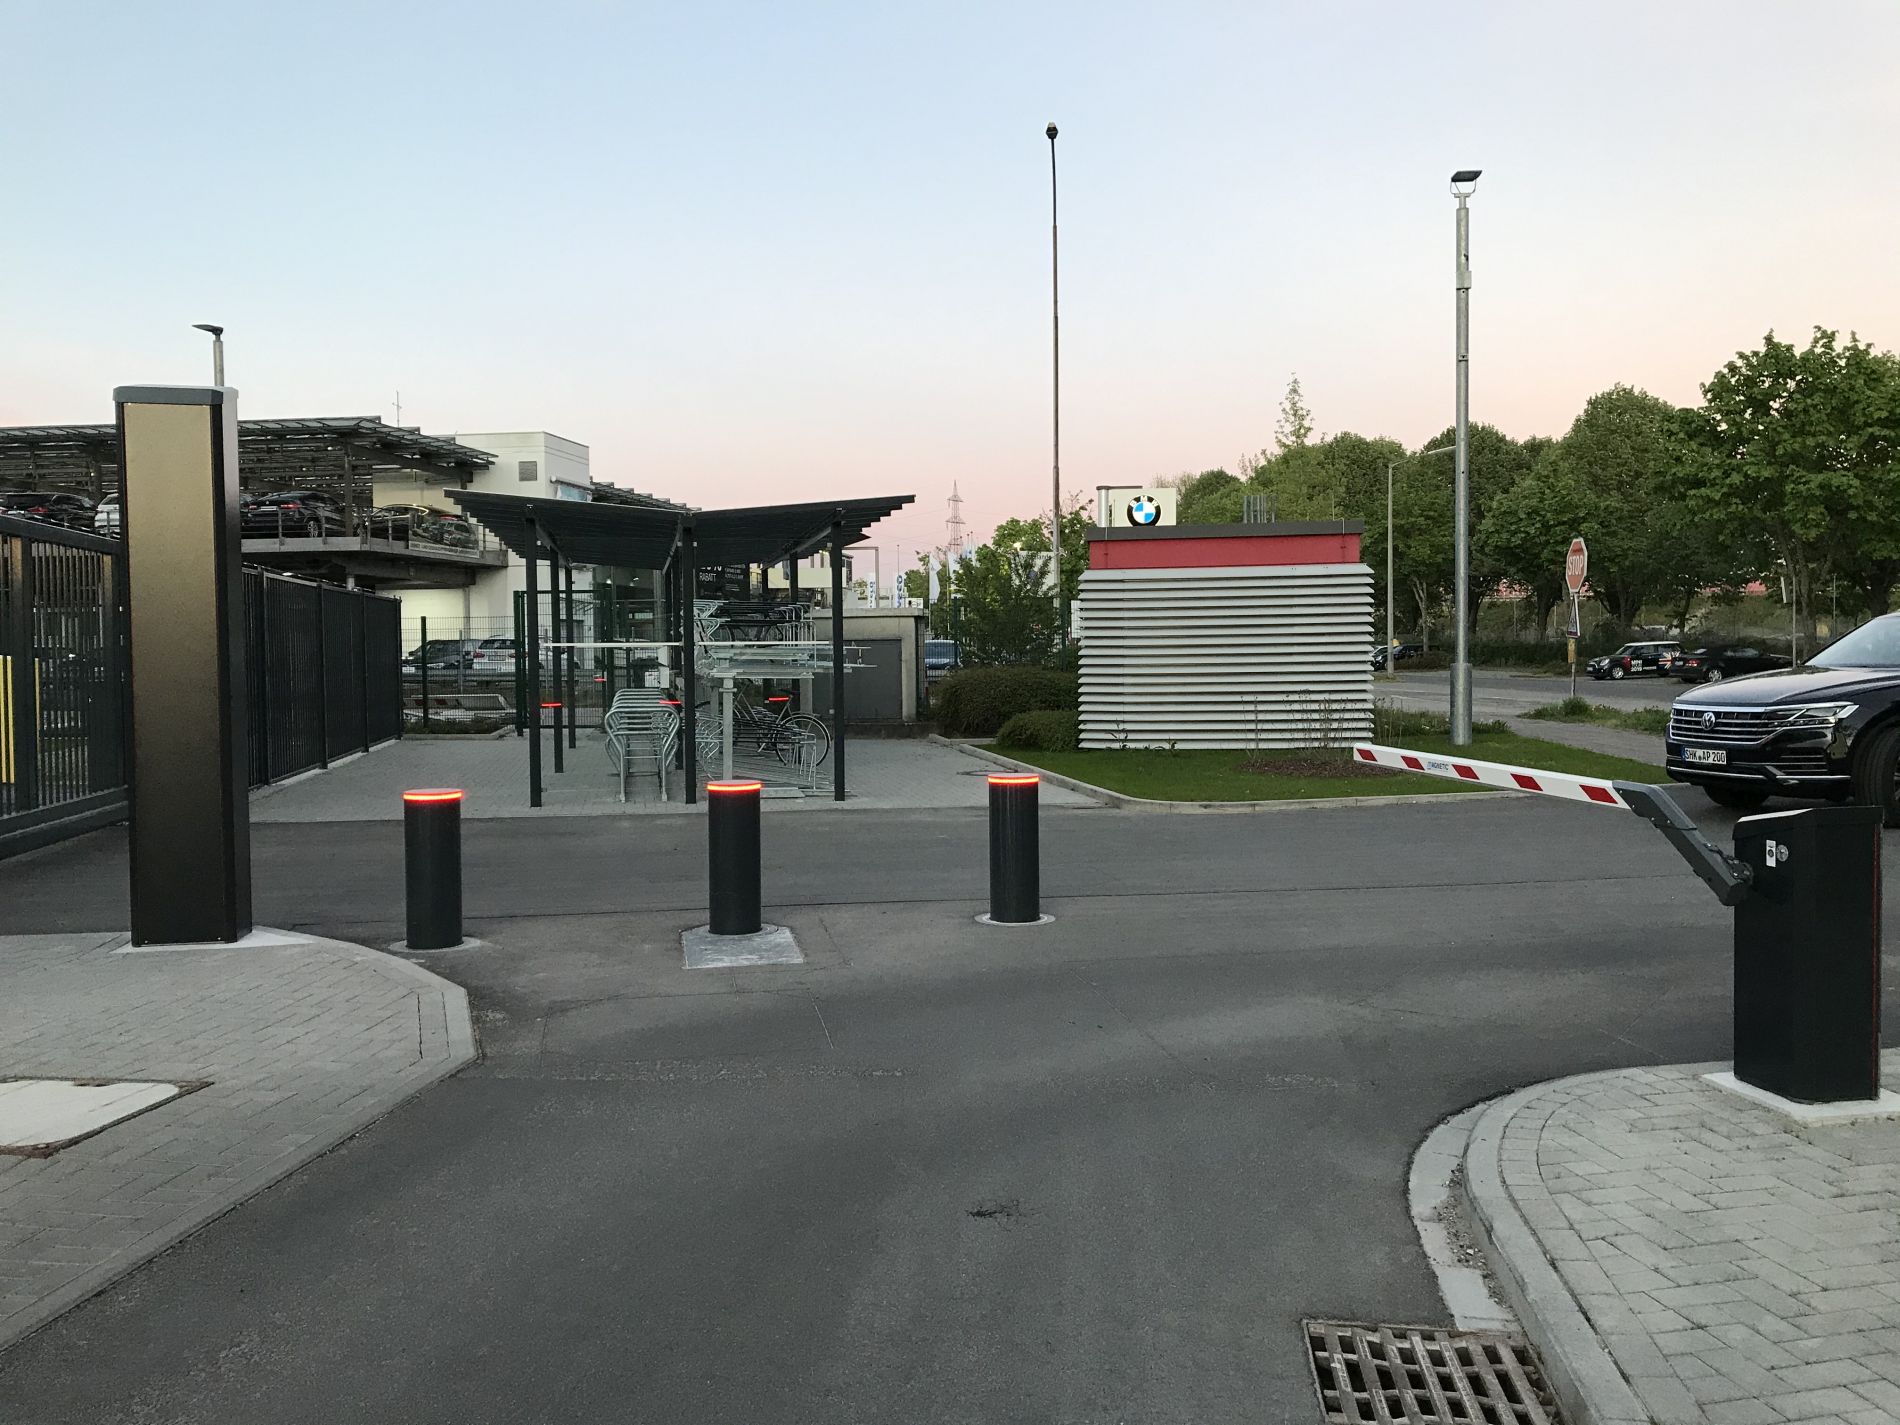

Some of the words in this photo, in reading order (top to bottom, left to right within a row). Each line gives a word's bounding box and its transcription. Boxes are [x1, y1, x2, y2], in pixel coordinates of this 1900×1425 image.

[1568, 555, 1584, 575] STOP
[1685, 749, 1698, 760] SHK
[1702, 750, 1710, 761] AP
